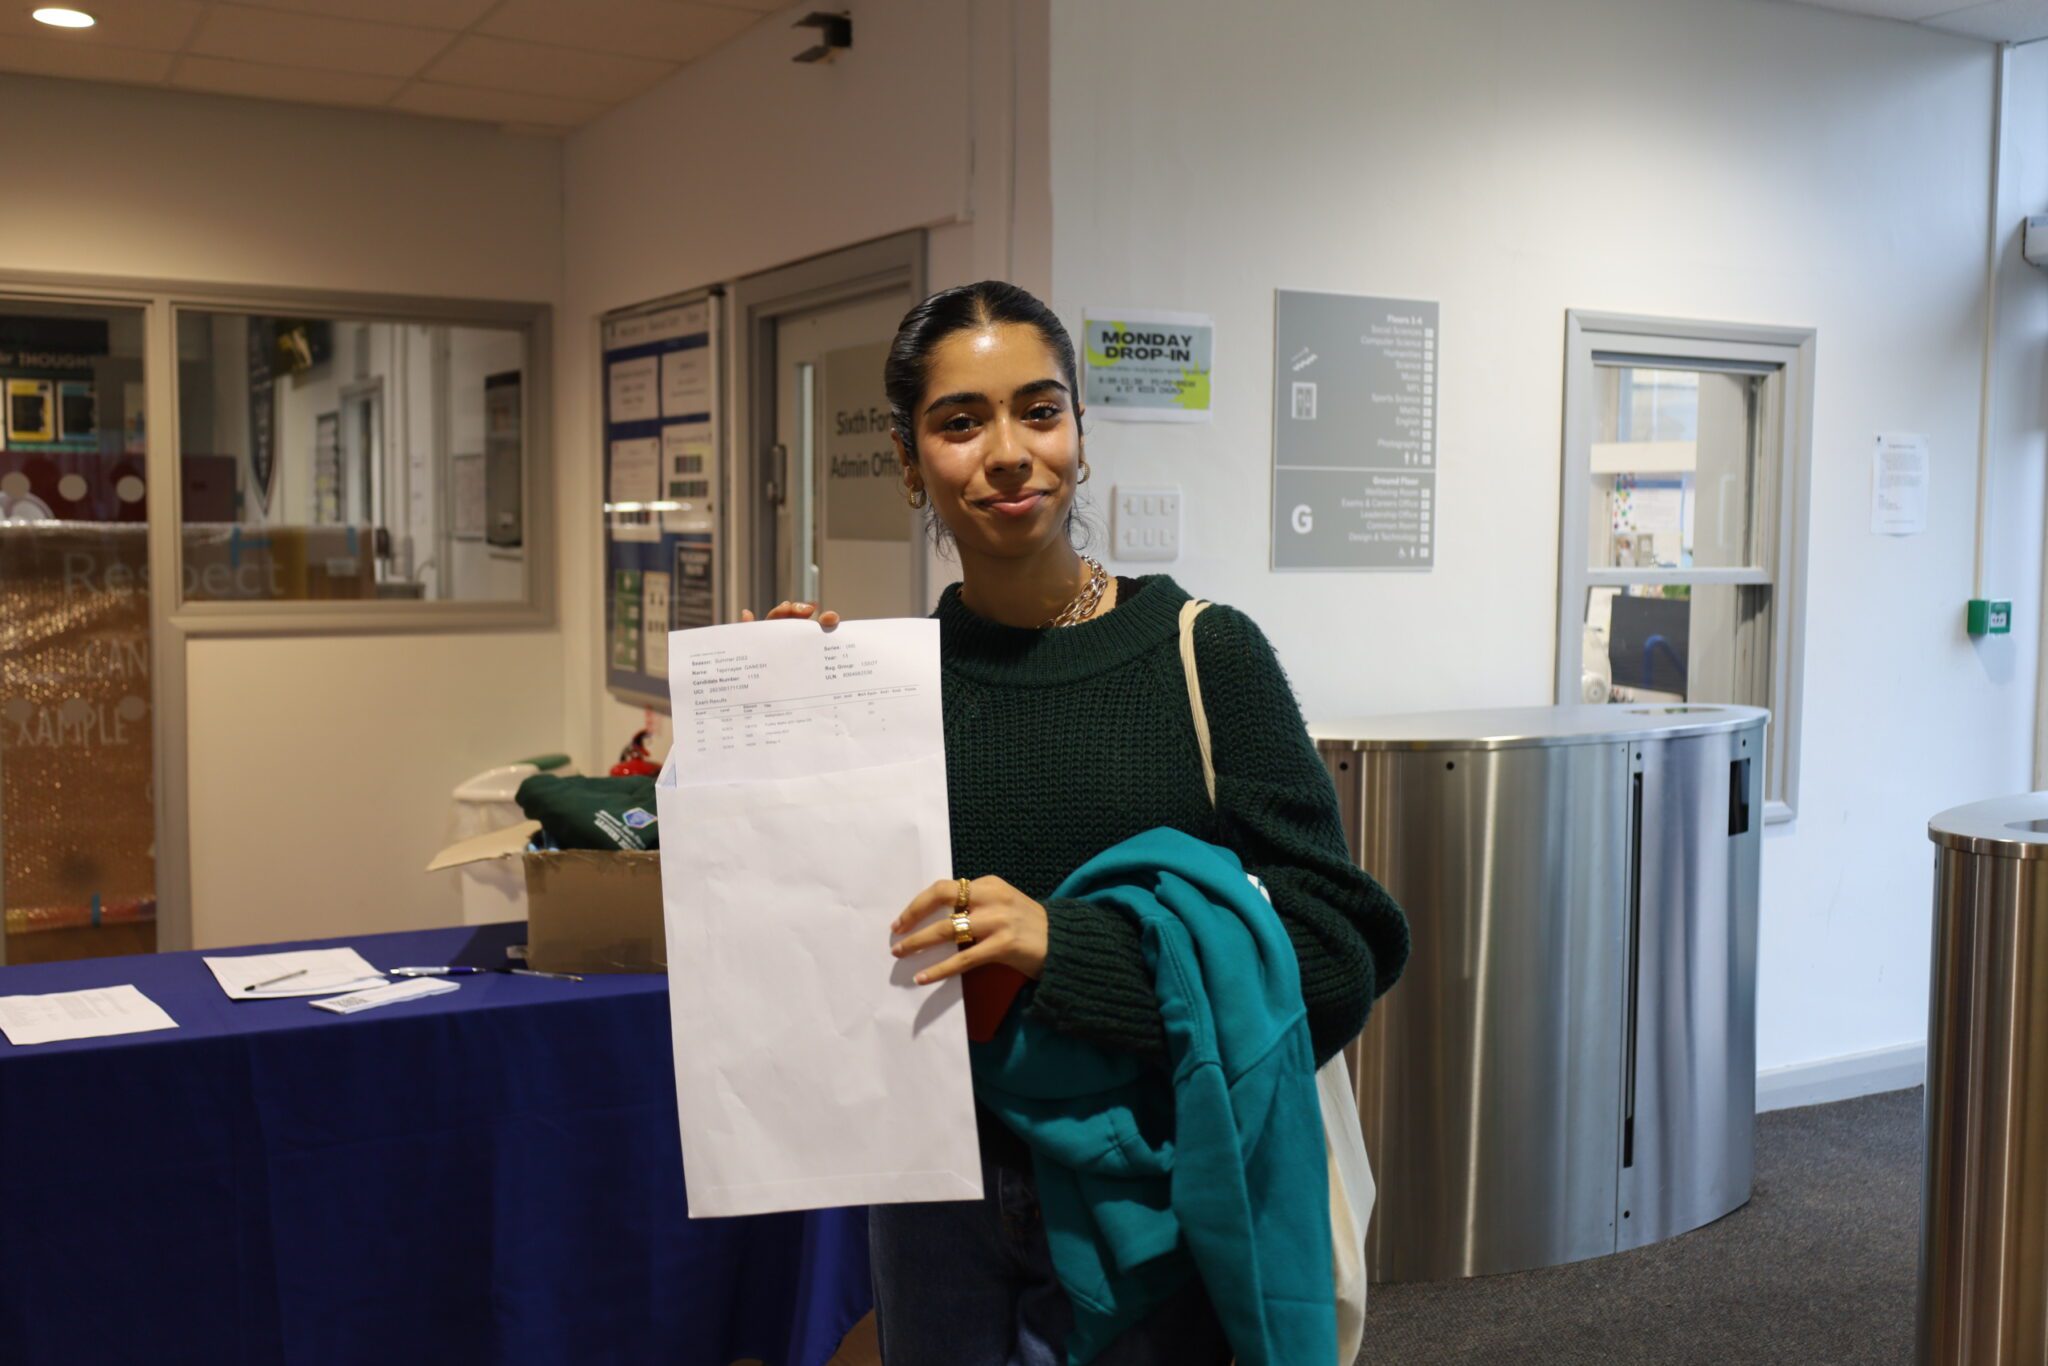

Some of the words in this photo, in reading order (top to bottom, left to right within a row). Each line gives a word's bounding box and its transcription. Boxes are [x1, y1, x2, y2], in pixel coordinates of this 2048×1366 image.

[1102, 331, 1193, 347] MONDAY
[1105, 346, 1190, 362] DROP-IN
[836, 410, 866, 435] Sixth
[868, 407, 896, 432] For
[831, 455, 869, 478] Admin
[1291, 504, 1313, 534] G
